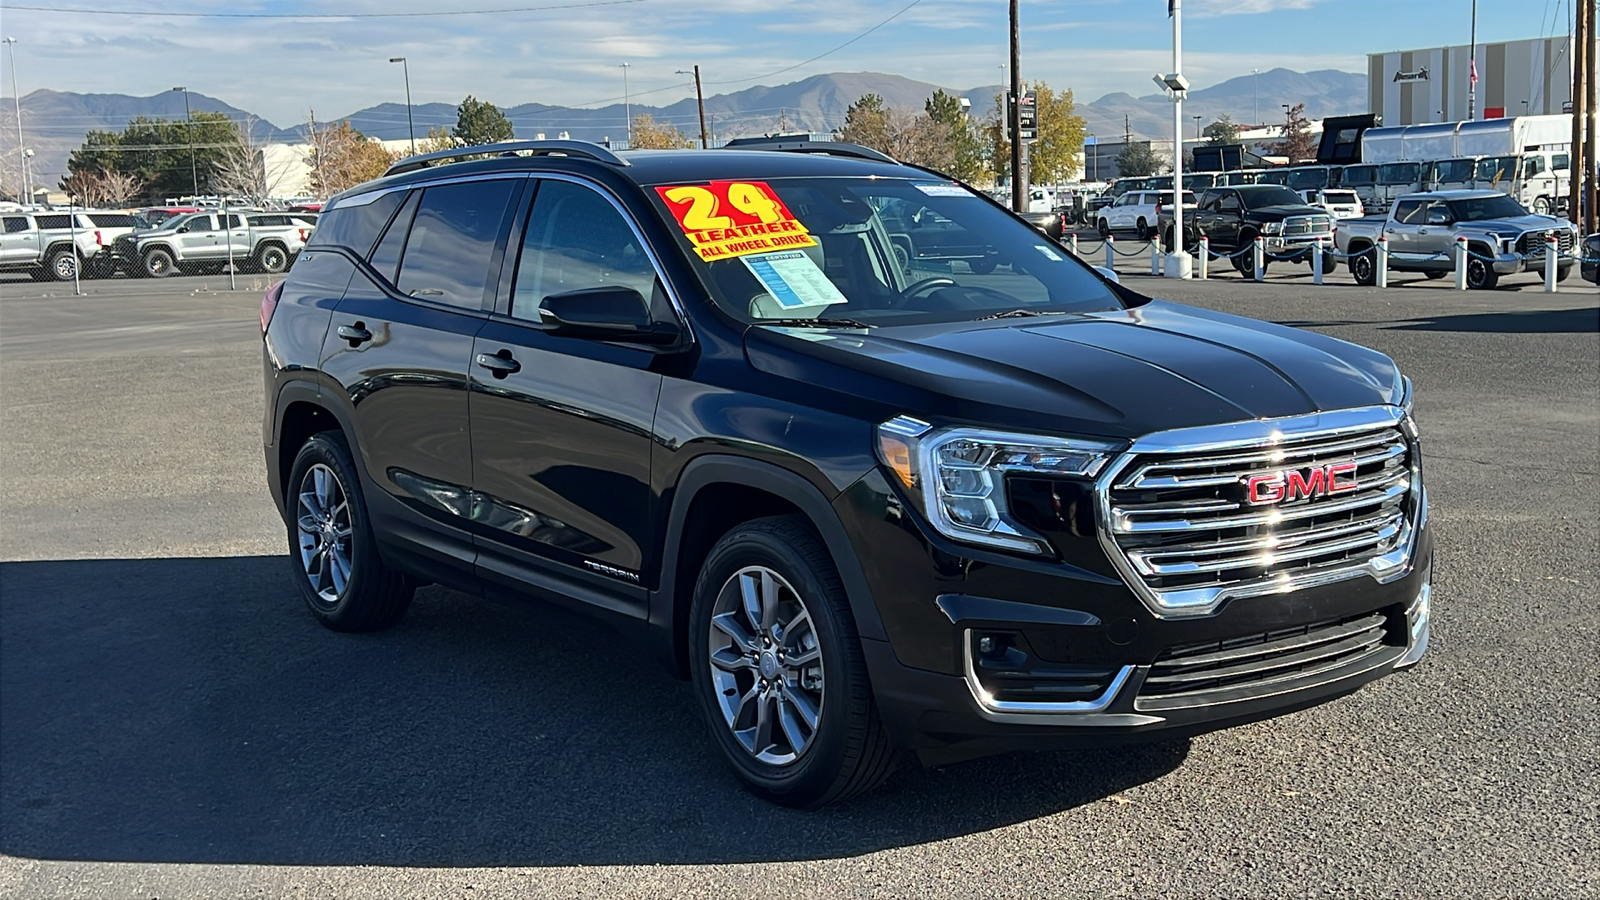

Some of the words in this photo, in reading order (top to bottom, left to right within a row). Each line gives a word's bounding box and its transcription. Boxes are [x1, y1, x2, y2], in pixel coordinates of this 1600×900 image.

[664, 183, 783, 230] 24
[695, 221, 798, 244] LEATHER
[701, 245, 726, 258] ALL
[725, 239, 771, 253] WHEEL
[771, 234, 810, 247] DRIVE
[765, 253, 801, 261] CERTIFIED
[1249, 463, 1358, 506] GMC
[584, 560, 640, 582] TERRAIN
